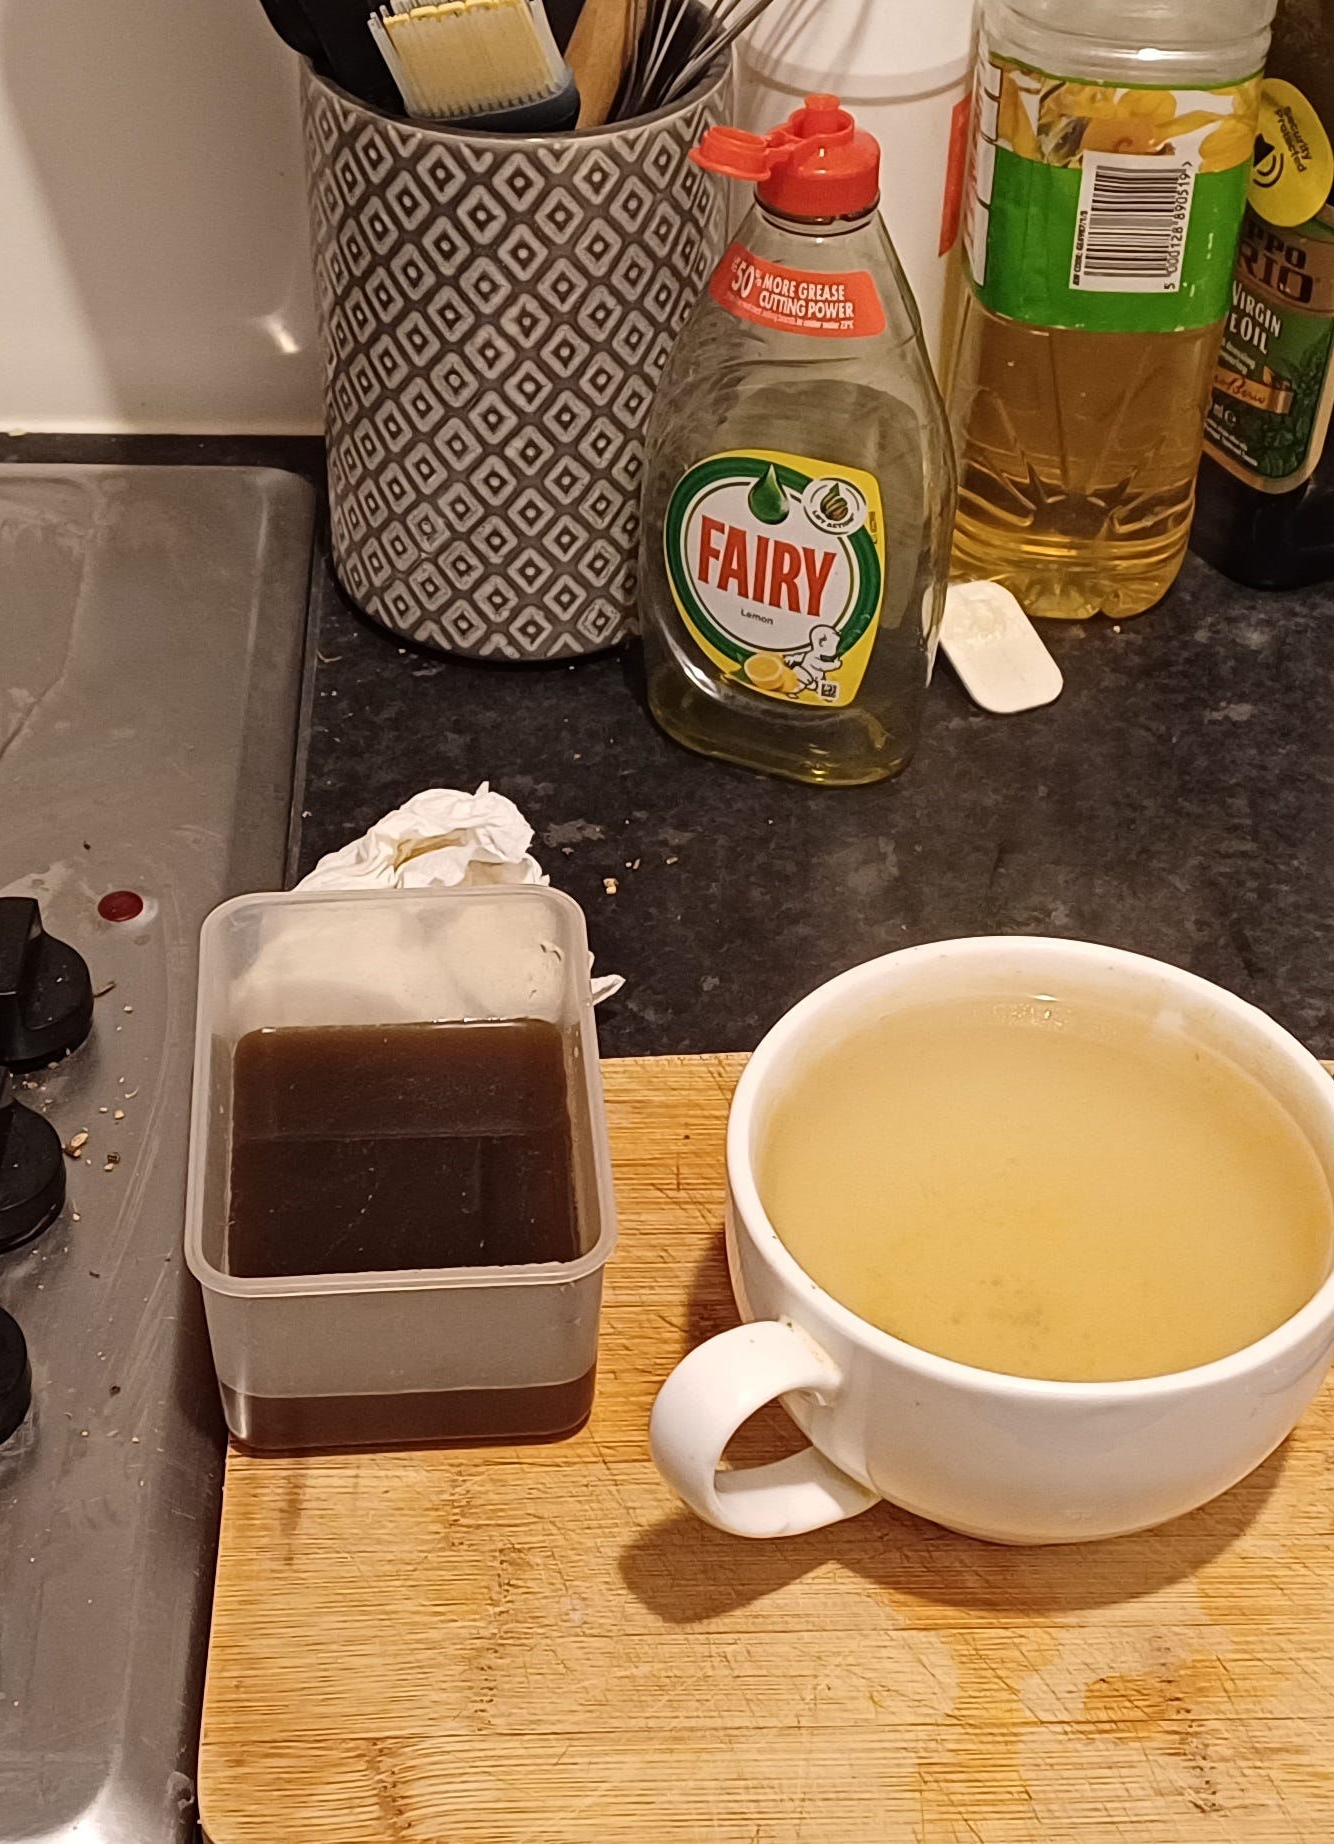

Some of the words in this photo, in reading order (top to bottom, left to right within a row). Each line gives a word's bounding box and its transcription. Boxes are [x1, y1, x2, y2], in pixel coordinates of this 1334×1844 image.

[1174, 173, 1191, 220] 890519
[1166, 226, 1183, 274] 000128
[762, 273, 796, 298] MORE
[798, 282, 845, 301] GREASE
[1164, 282, 1175, 290] 5
[759, 292, 806, 317] CUTTING
[807, 302, 855, 319] POWER
[1232, 280, 1281, 338] VIRGIN
[1240, 317, 1267, 355] OIL
[697, 514, 838, 618] FAIRY
[740, 608, 774, 626] Lemon
